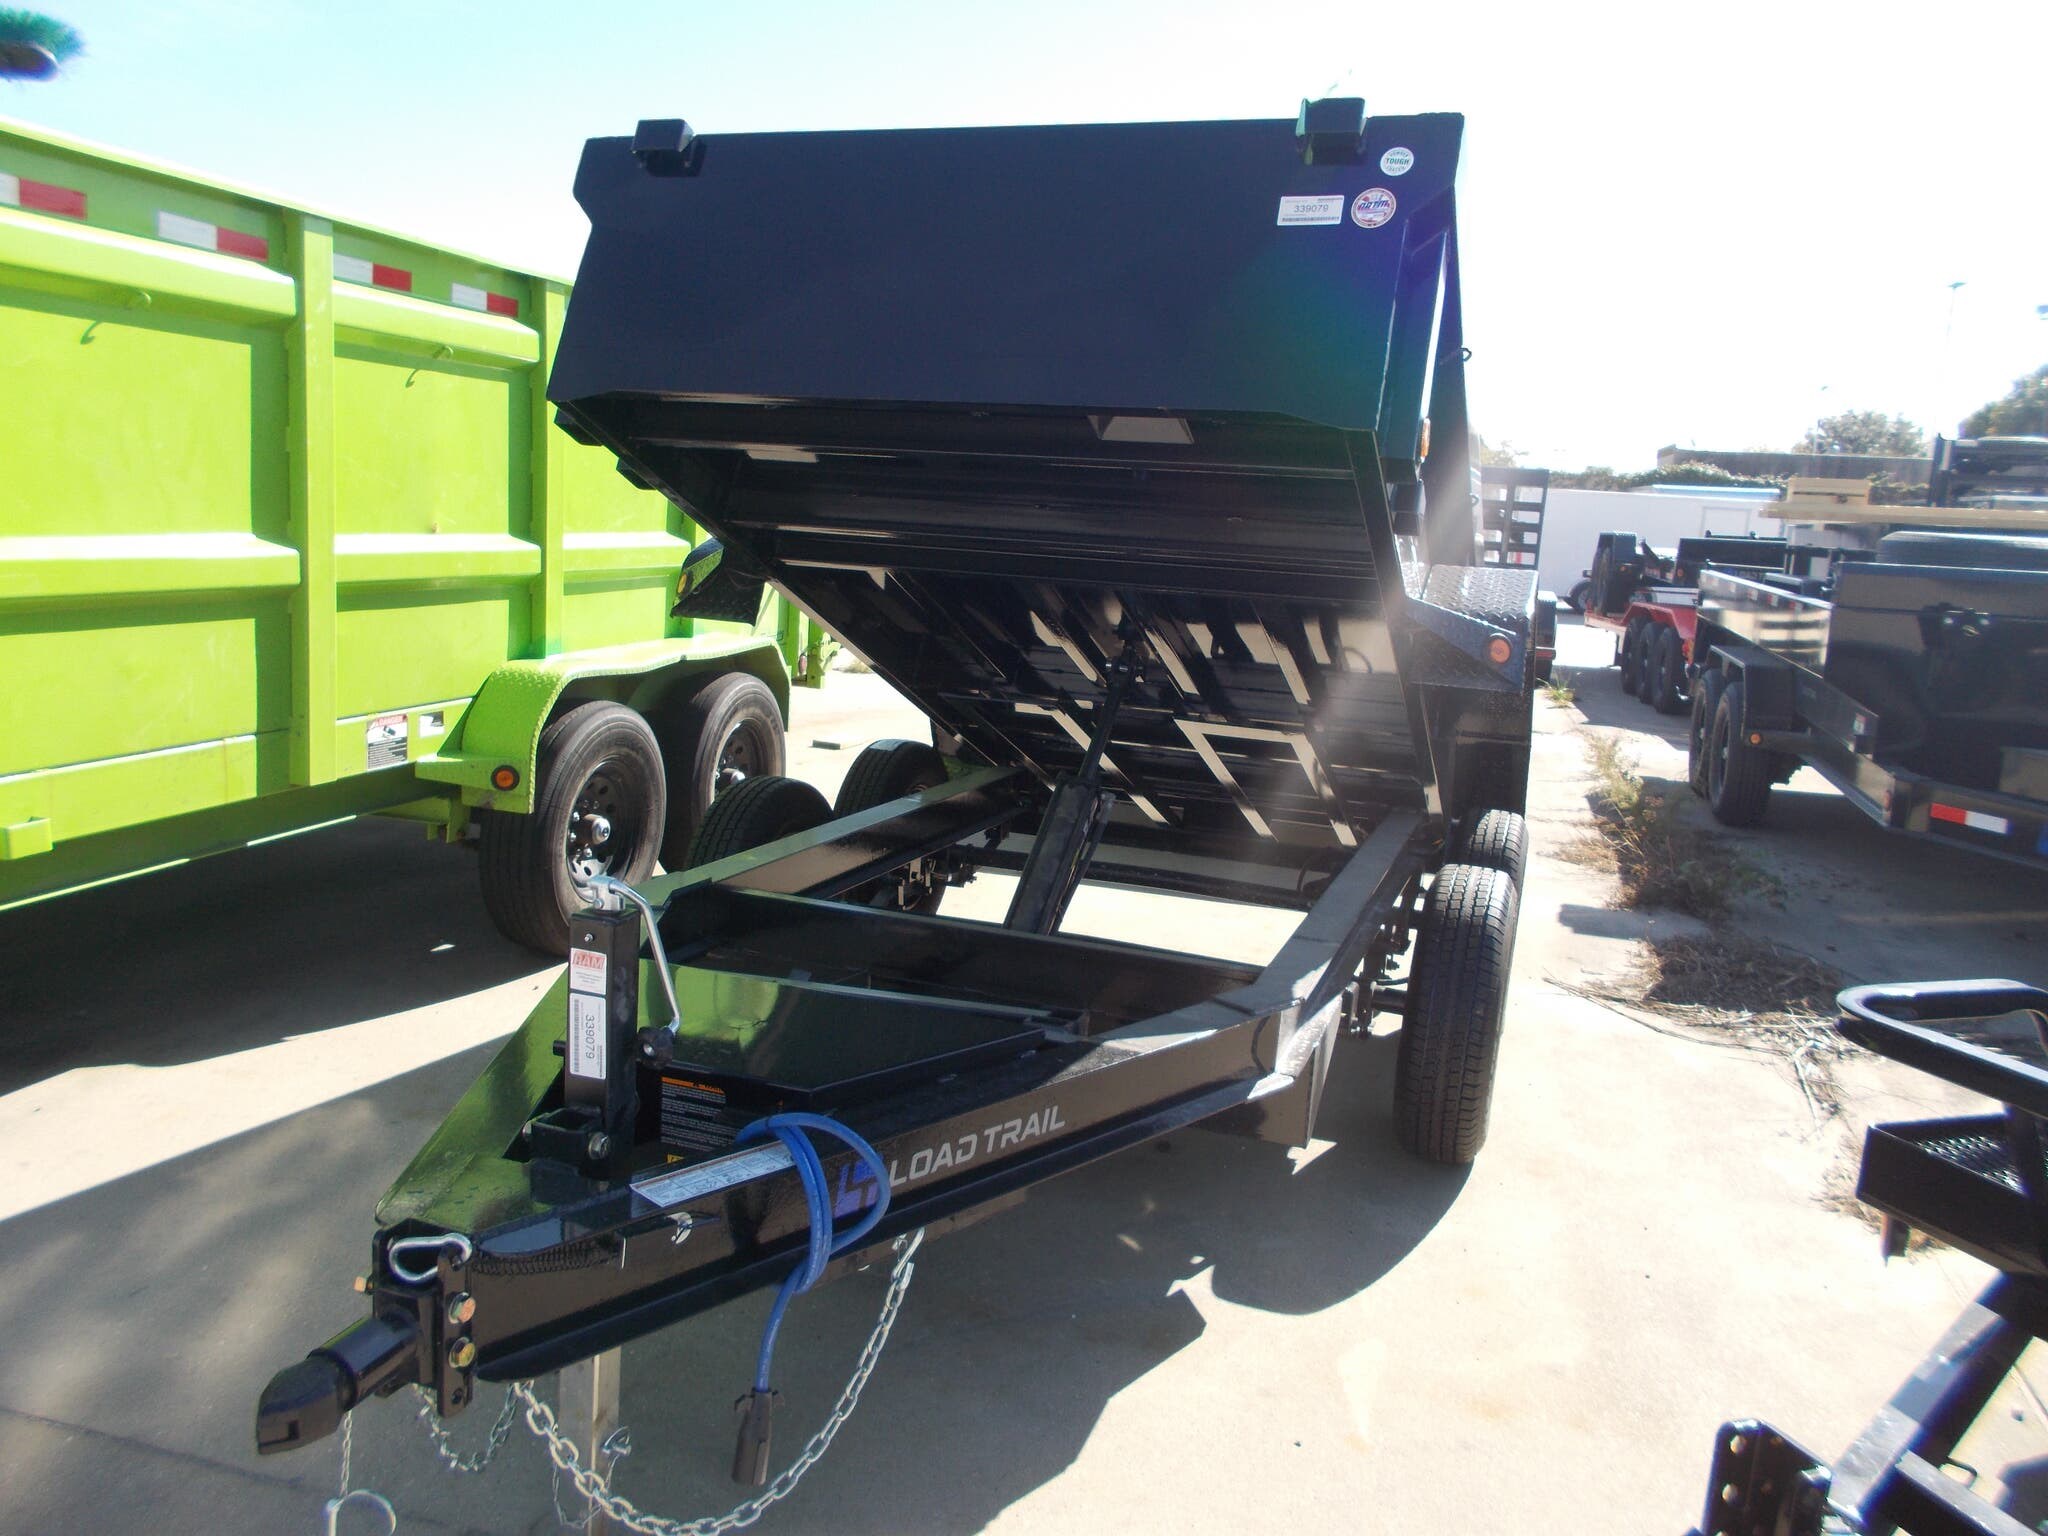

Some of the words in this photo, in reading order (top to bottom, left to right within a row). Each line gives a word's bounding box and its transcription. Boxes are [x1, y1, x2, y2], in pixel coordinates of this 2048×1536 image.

[1294, 204, 1329, 213] 339079
[585, 1015, 595, 1059] 339079
[889, 1132, 977, 1187] LOAD
[984, 1105, 1066, 1153] TRAIL
